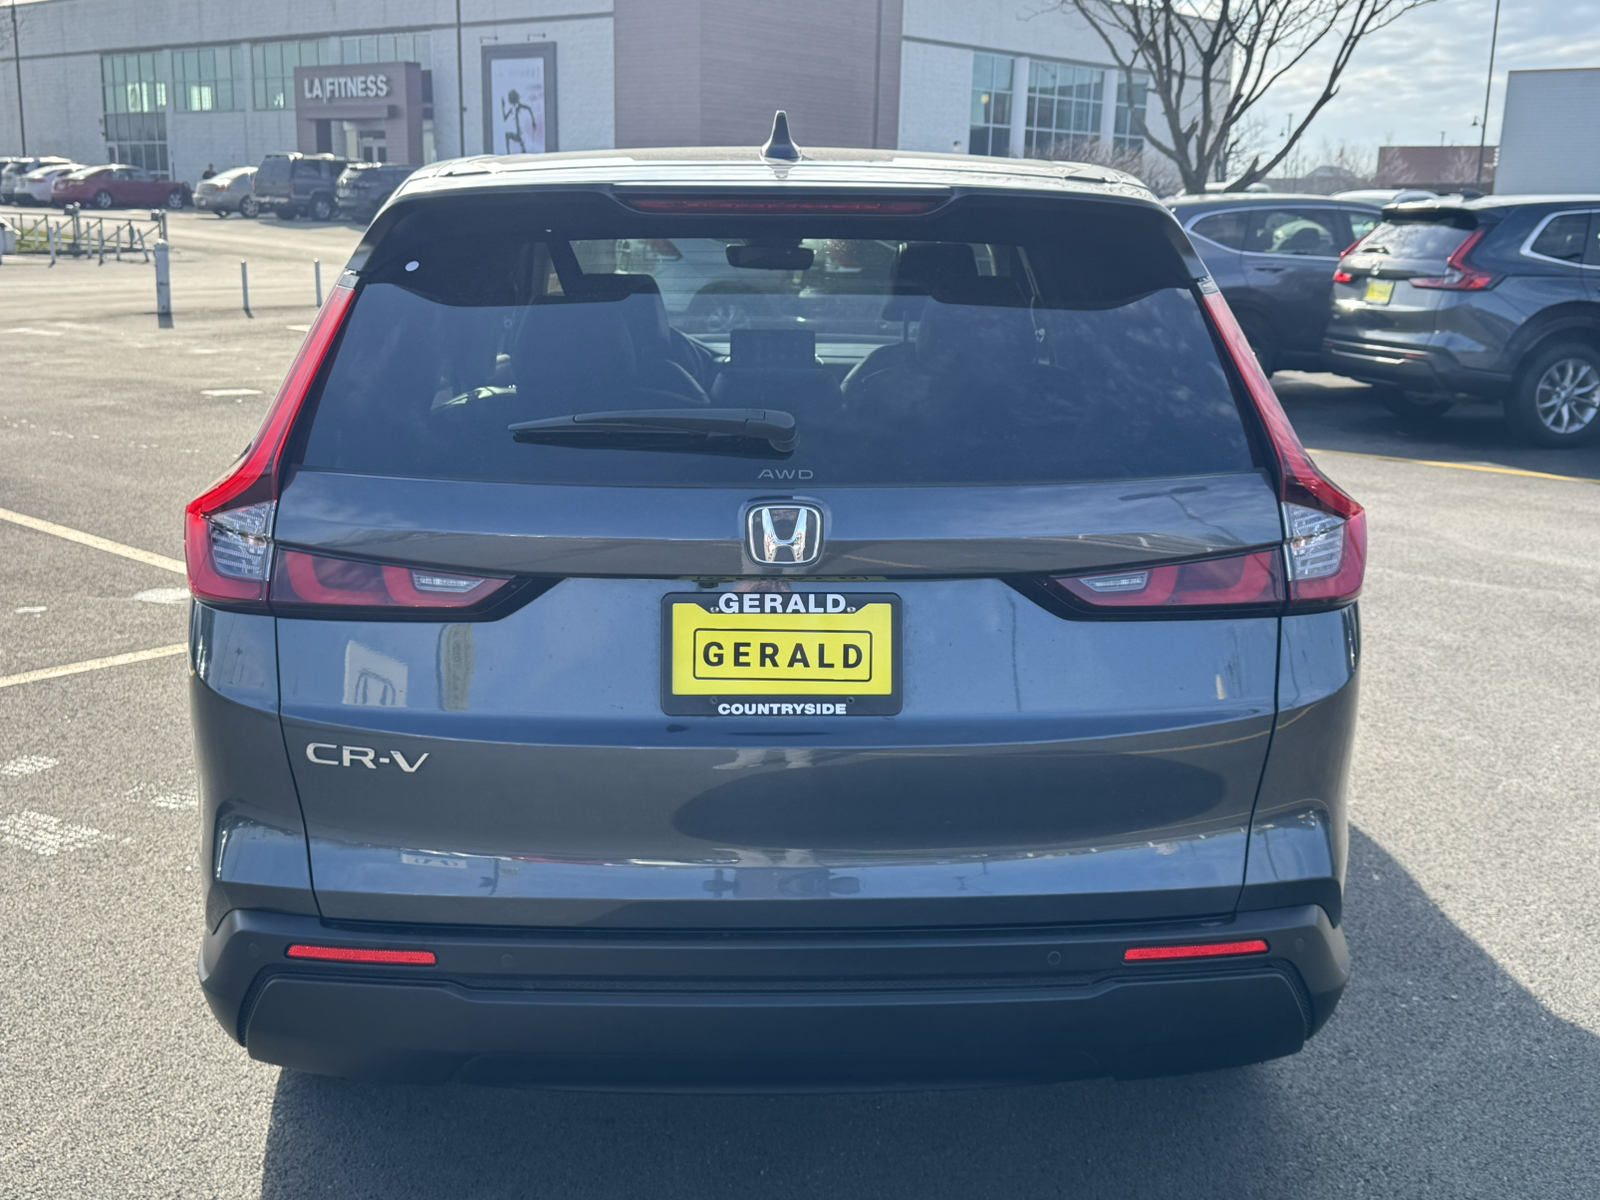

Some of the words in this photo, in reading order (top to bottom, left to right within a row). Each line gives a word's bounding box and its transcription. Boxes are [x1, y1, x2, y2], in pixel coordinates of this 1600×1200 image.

[303, 78, 323, 99] LA
[325, 74, 388, 98] FITNESS
[758, 469, 814, 479] AWD
[718, 593, 846, 613] GERALD
[702, 641, 863, 669] GERALD
[717, 703, 847, 715] COUNTRYSIDE
[306, 742, 430, 773] CR-V
